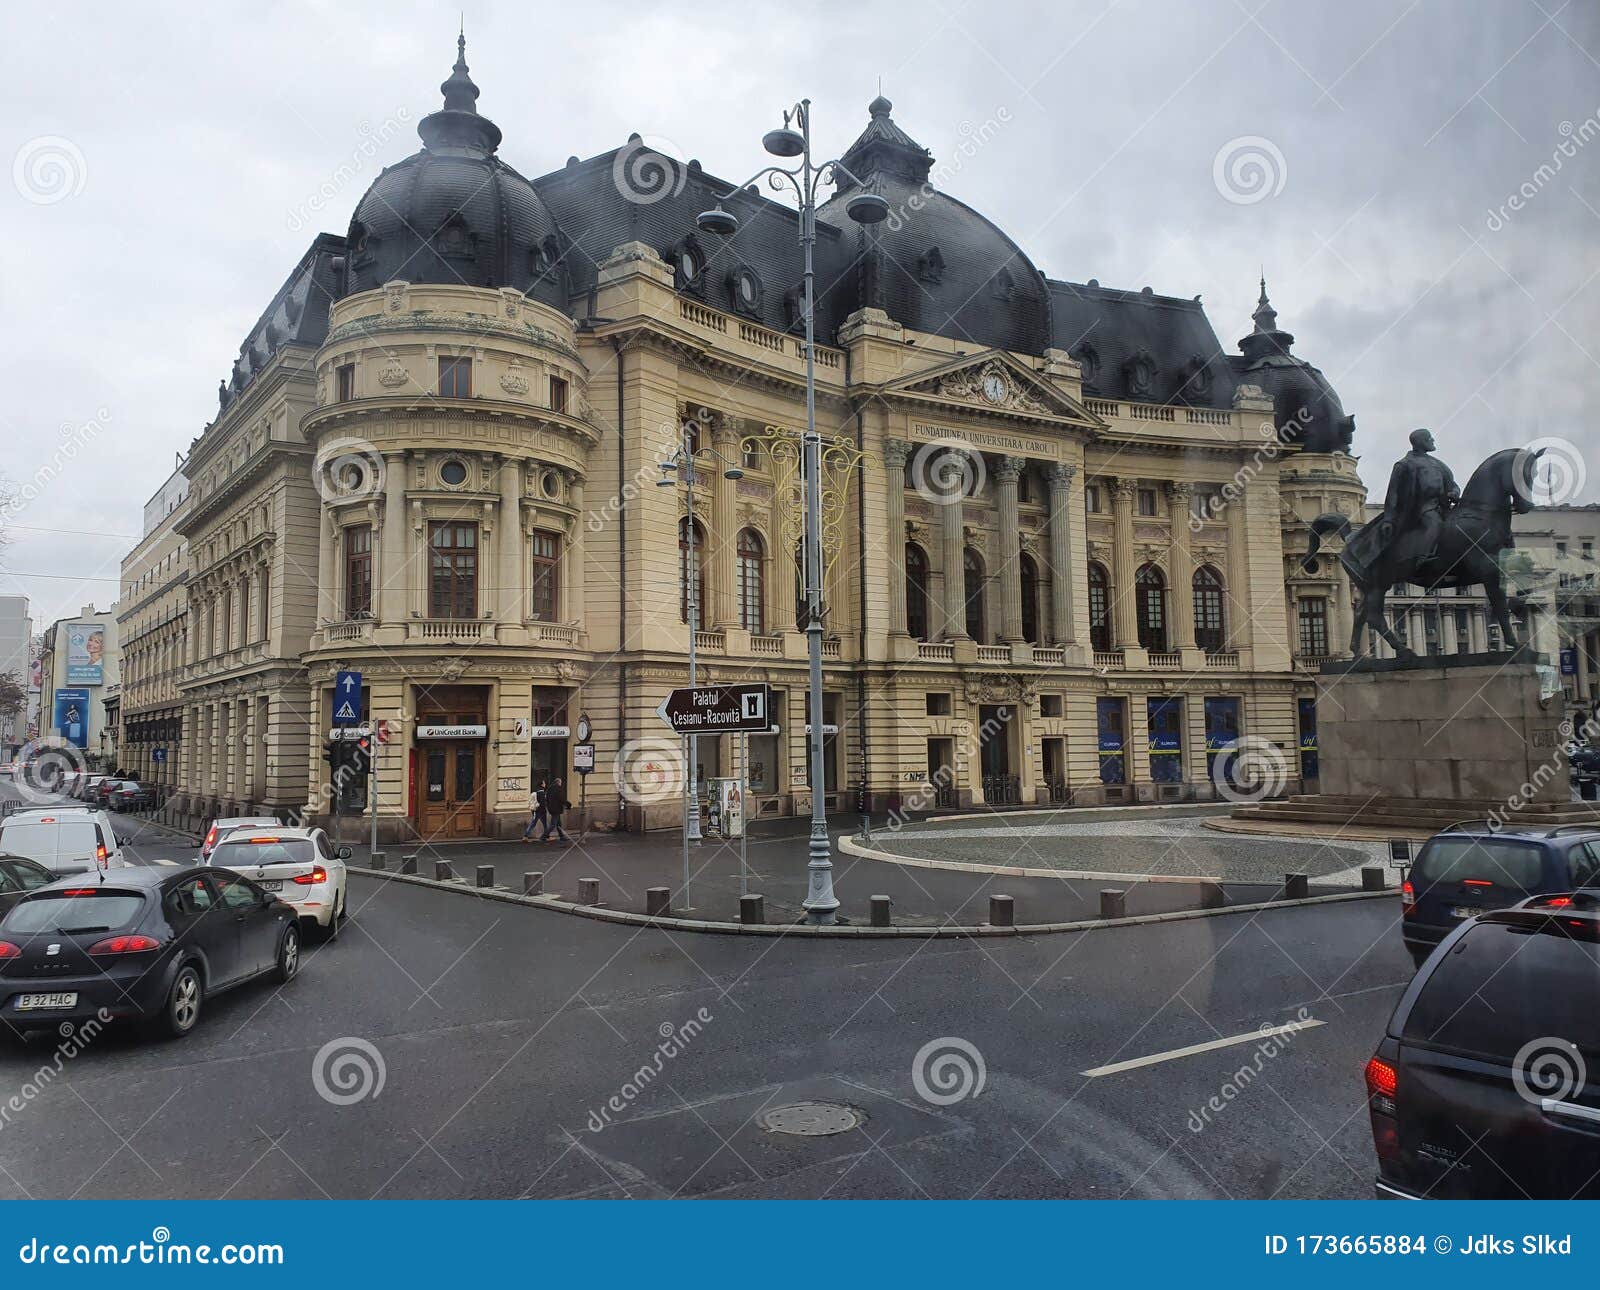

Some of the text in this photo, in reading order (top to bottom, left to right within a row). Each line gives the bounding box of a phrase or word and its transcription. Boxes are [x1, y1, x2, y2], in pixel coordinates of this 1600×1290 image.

[969, 432, 1023, 449] UNIVERSITARA
[692, 691, 719, 706] Palatul
[22, 994, 72, 1006] B 32 HAC
